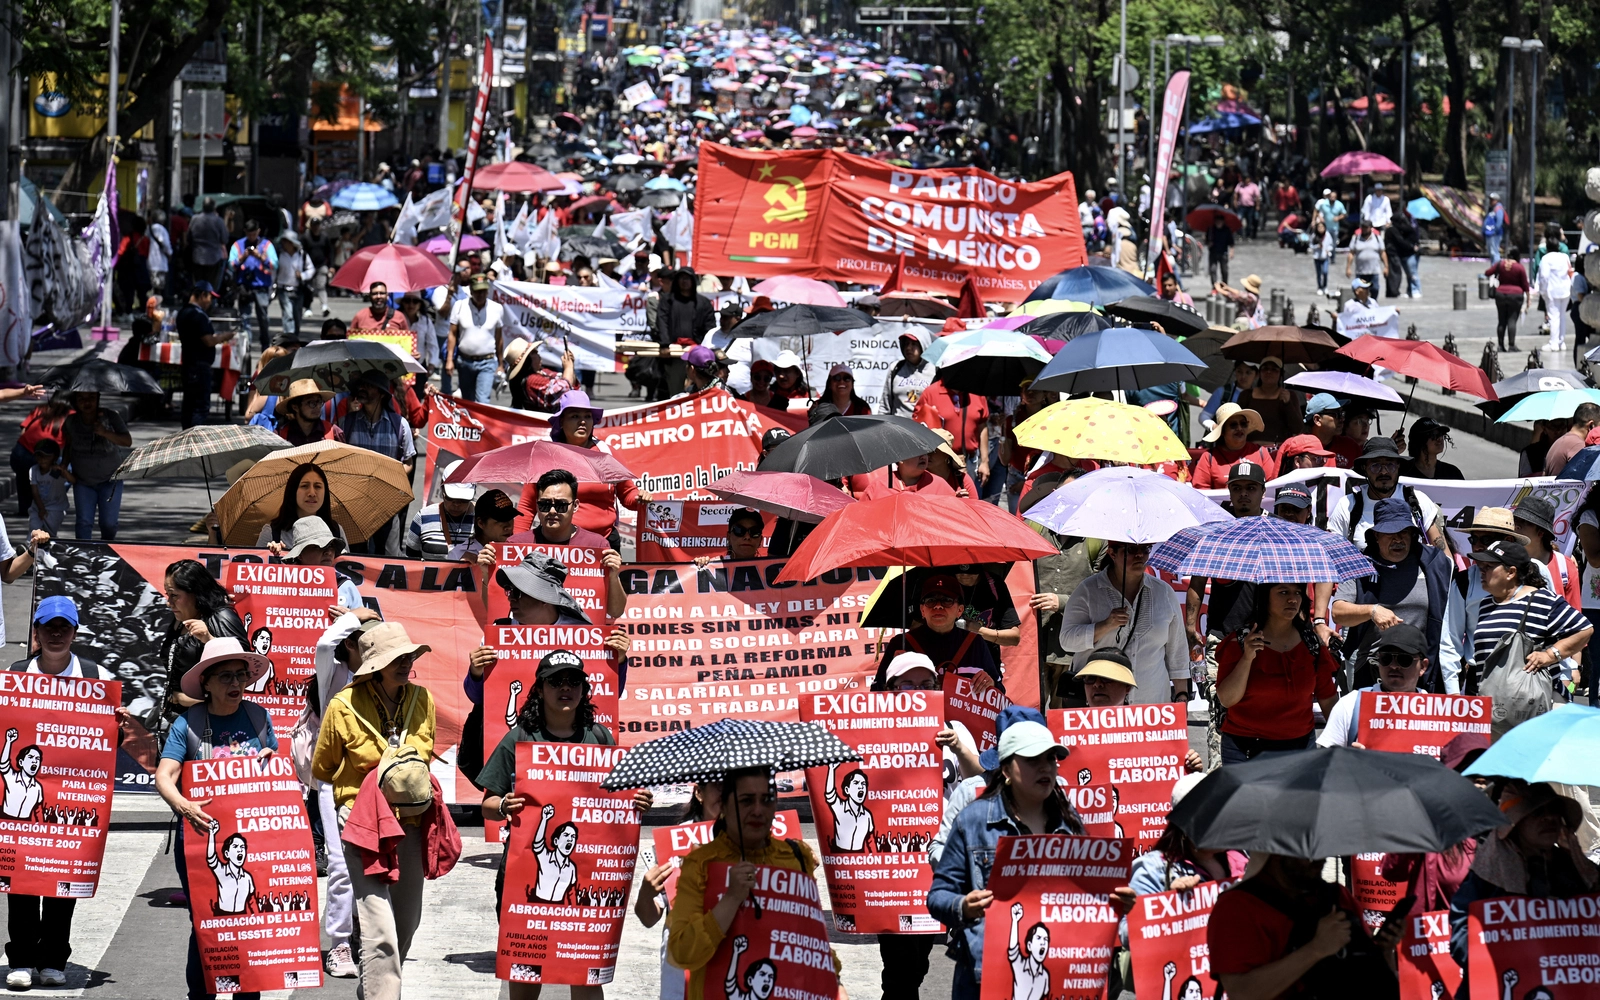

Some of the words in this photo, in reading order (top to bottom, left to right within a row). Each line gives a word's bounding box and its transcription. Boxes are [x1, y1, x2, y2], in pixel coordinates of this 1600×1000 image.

[889, 171, 1017, 205] PARTIDO
[860, 196, 1047, 238] COMUNISTA
[749, 231, 799, 250] PCM
[867, 225, 916, 257] DE
[927, 233, 1041, 271] MÉXICO
[922, 268, 939, 280] DE
[976, 276, 991, 287] LOS
[492, 289, 548, 309] Asamblea
[551, 295, 603, 314] Nacional
[665, 400, 695, 421] DE
[700, 395, 763, 428] LUCA
[434, 422, 481, 441] CNTE
[604, 425, 695, 450] CENTRO
[634, 472, 681, 494] eforma
[685, 475, 694, 489] a
[696, 466, 709, 487] la
[712, 464, 732, 483] ley
[700, 505, 739, 517] Secció
[641, 532, 680, 548] EXIGIMOS
[681, 536, 728, 548] REINSTALA
[236, 564, 325, 585] EXIGIMOS
[375, 563, 408, 590] A
[420, 566, 477, 592] LA
[251, 585, 262, 595] DE
[262, 585, 298, 597] AUMENTO
[298, 588, 335, 598] SALARIAL
[265, 607, 325, 617] SEGURIDAD
[690, 607, 705, 618] A
[711, 605, 736, 617] LA
[743, 602, 782, 616] LEY
[787, 599, 827, 612] DEL
[702, 620, 740, 634] SIN
[827, 613, 850, 625] NI
[499, 627, 603, 646] EXIGIMOS
[709, 634, 793, 649] SOCIAL
[799, 628, 858, 644] PARA
[549, 651, 577, 660] STAR
[549, 657, 580, 666] WARS
[690, 655, 705, 667] A
[711, 653, 738, 665] LA
[743, 645, 852, 664] REFORMA
[697, 663, 828, 682] PEÑA-AMLO
[0, 673, 106, 700] EXIGIMOS
[635, 684, 743, 701] SALARIAL
[750, 681, 790, 696] DEL
[796, 677, 859, 693] 100%
[20, 697, 31, 708] DE
[32, 699, 74, 712] AUMENTO
[75, 702, 116, 715] SALARIAL
[651, 702, 693, 716] LOS
[813, 691, 927, 715] EXIGIMOS
[1375, 694, 1484, 719] EXIGIMOS
[837, 719, 850, 731] DE
[850, 717, 895, 730] AUMENTO
[895, 716, 940, 728] SALARIAL
[1063, 705, 1176, 731] EXIGIMOS
[1368, 718, 1386, 730] 100
[1395, 719, 1408, 731] DE
[1407, 719, 1451, 732] AUMENTO
[35, 722, 104, 737] SEGURIDAD
[1059, 734, 1076, 747] 100
[1088, 733, 1100, 746] DE
[1100, 731, 1145, 745] AUMENTO
[1145, 728, 1188, 742] SALARIAL
[35, 733, 112, 752] LABORAL
[857, 742, 930, 755] SEGURIDAD
[858, 753, 940, 770] LABORAL
[1108, 755, 1179, 769] SEGURIDAD
[40, 766, 108, 779] BASIFICACIÓN
[526, 768, 545, 781] 100
[555, 770, 567, 782] DE
[1109, 766, 1185, 784] LABORAL
[62, 779, 86, 790] PARA
[88, 781, 107, 791] L@S
[215, 785, 227, 796] DE
[227, 781, 271, 795] AUMENTO
[867, 786, 939, 800] BASIFICACIÓN
[57, 791, 106, 804] INTERIN@S
[235, 804, 300, 819] SEGURIDAD
[571, 808, 642, 825] LABORAL
[49, 825, 64, 835] DE
[66, 827, 80, 836] LA
[82, 828, 102, 838] LEY
[236, 815, 309, 833] LABORAL
[18, 836, 54, 848] ISSSTE
[55, 839, 82, 850] 2007
[575, 843, 637, 855] BASIFICACIÓN
[1010, 837, 1123, 862] EXIGIMOS
[25, 856, 69, 866] Trabajadoras
[73, 859, 83, 867] 28
[247, 849, 310, 863] BASIFICACIÓN
[73, 867, 82, 875] 30
[83, 867, 97, 876] años
[272, 864, 296, 874] PARA
[1001, 864, 1016, 877] 100
[1027, 864, 1039, 876] DE
[1039, 864, 1083, 877] AUMENTO
[1084, 865, 1127, 879] SALARIAL
[1376, 887, 1397, 896] AÑOS
[508, 903, 581, 918] ABROGACIÓN
[1040, 905, 1118, 924] LABORAL
[200, 915, 265, 930] ABROGACIÓN
[267, 915, 281, 924] DE
[284, 913, 299, 923] LA
[299, 912, 315, 922] LEY
[550, 920, 586, 932] ISSSTE
[238, 929, 273, 941] ISSSTE
[275, 926, 301, 938] 2007
[505, 931, 549, 942] JUBILACIÓN
[1140, 924, 1160, 939] 100
[1172, 921, 1184, 935] DE
[1478, 929, 1499, 945] 100
[1513, 927, 1528, 941] DE
[1529, 924, 1580, 939] AUMENTO
[203, 945, 239, 954] JUBILACIÓN
[510, 941, 528, 949] POR
[529, 941, 548, 951] AÑOS
[1048, 946, 1112, 960] BASIFICACIÓN
[1410, 944, 1428, 957] 100
[1437, 940, 1450, 954] DE
[222, 953, 240, 961] AÑOS
[501, 949, 512, 957] DE
[512, 950, 547, 960] SERVICIO
[769, 943, 836, 973] LABORAL
[213, 963, 241, 971] SERVICIO
